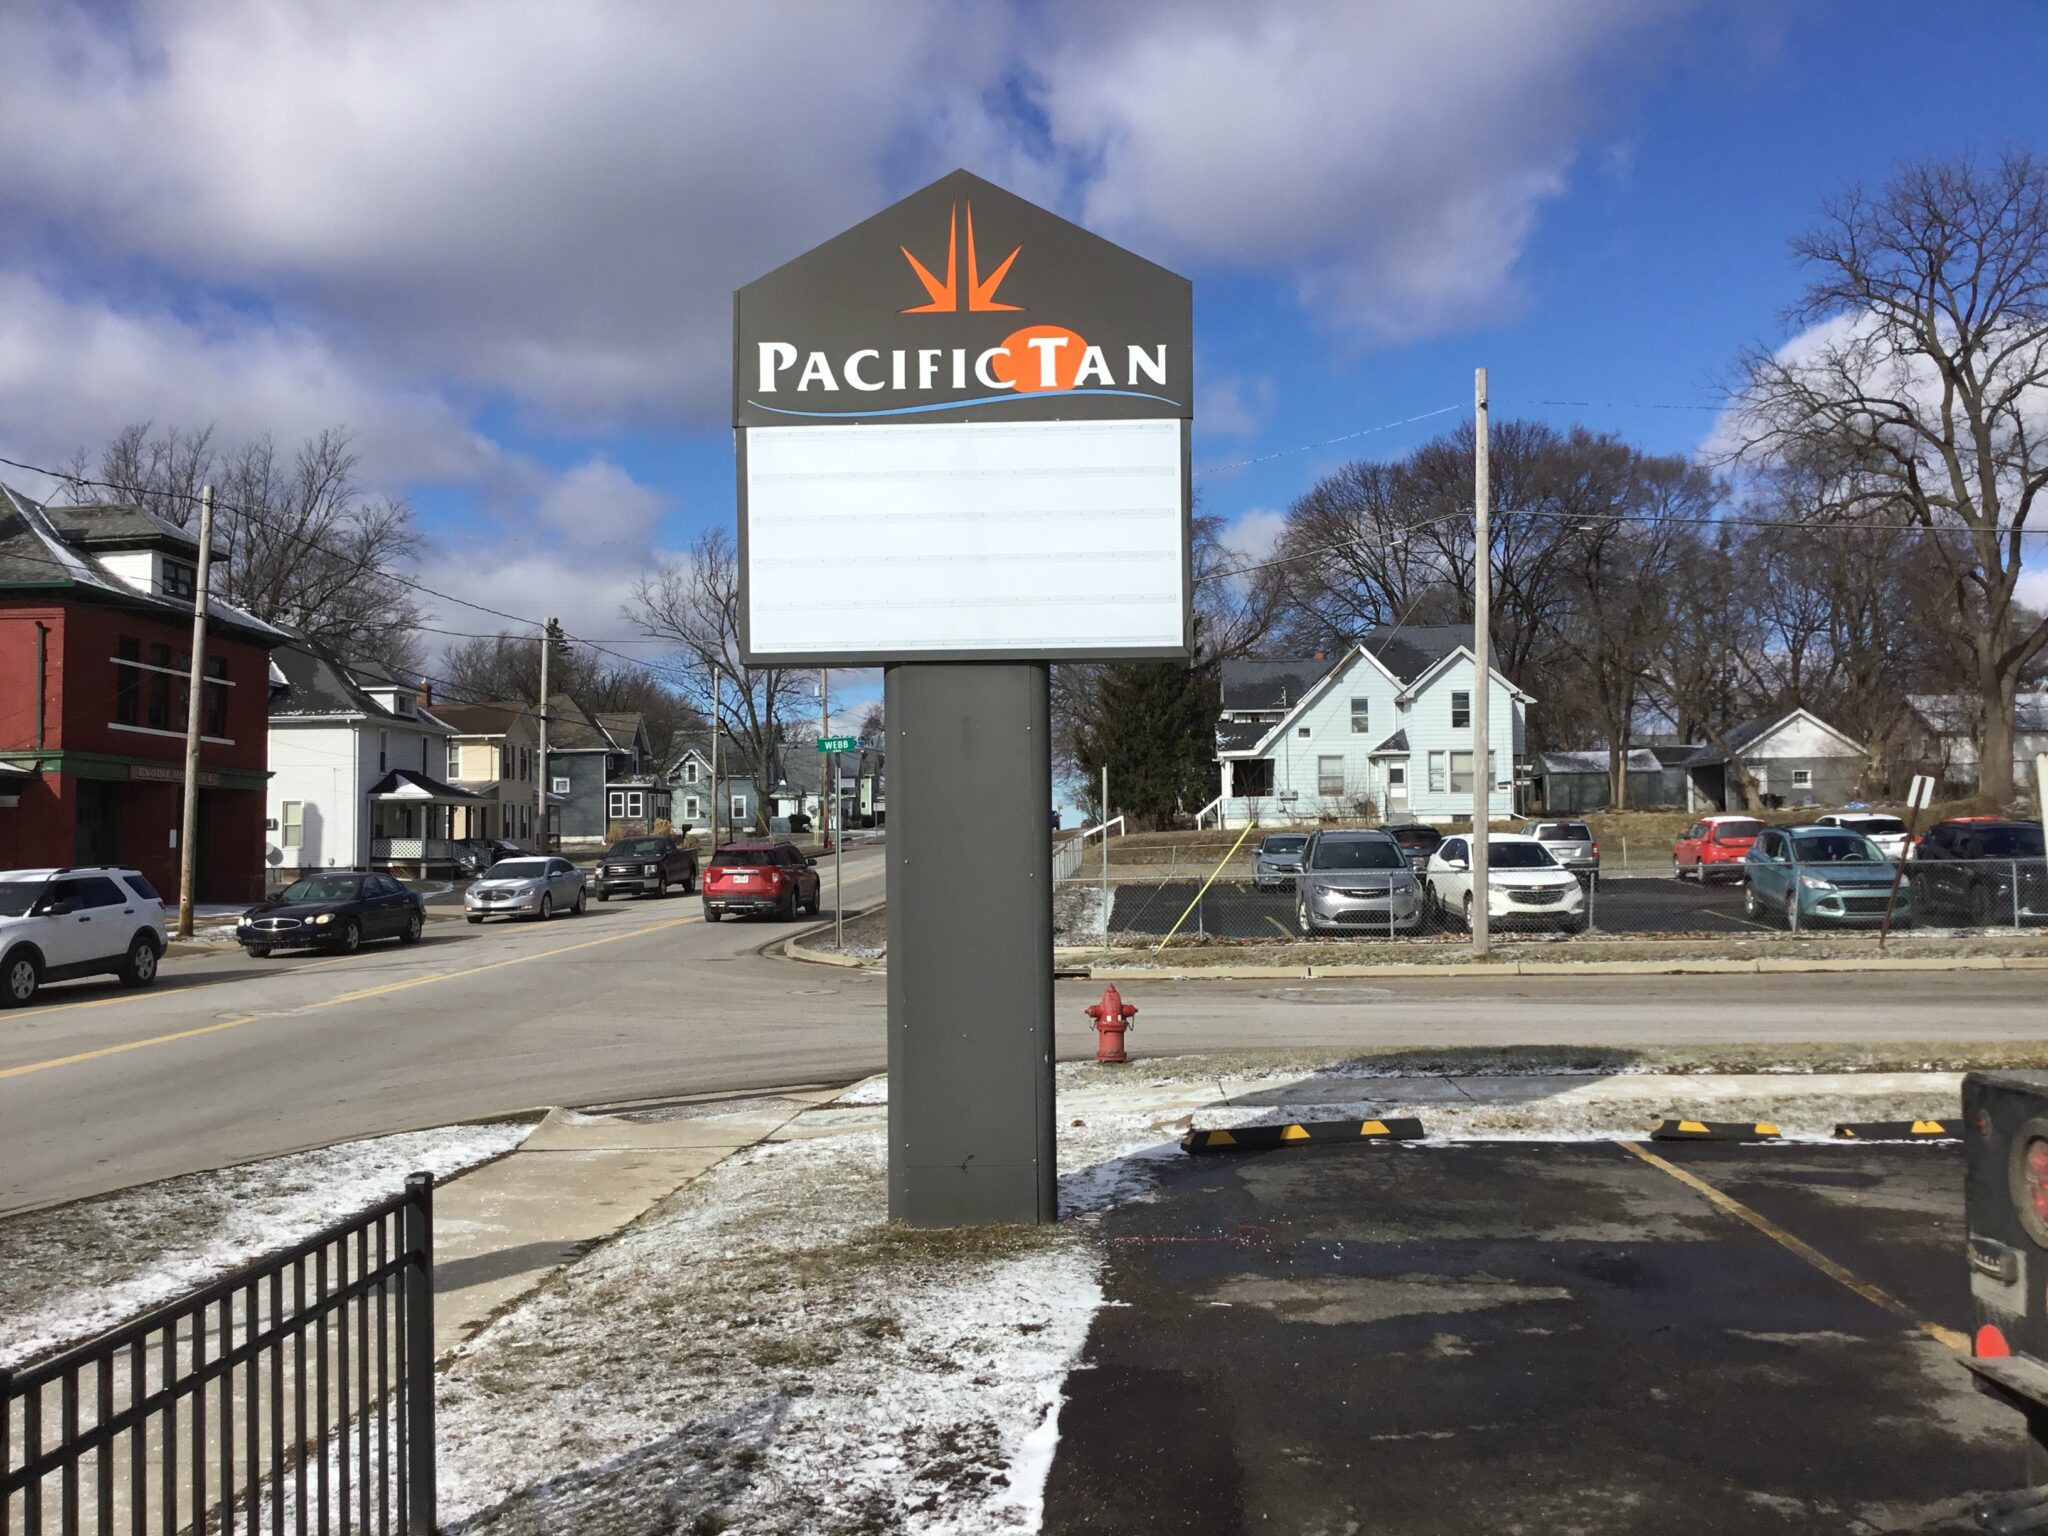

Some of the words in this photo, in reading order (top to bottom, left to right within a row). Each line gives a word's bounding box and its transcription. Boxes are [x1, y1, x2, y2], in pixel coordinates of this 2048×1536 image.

[757, 341, 1017, 392] PACIFIC
[1027, 336, 1168, 388] TAN
[824, 740, 848, 749] WEBB
